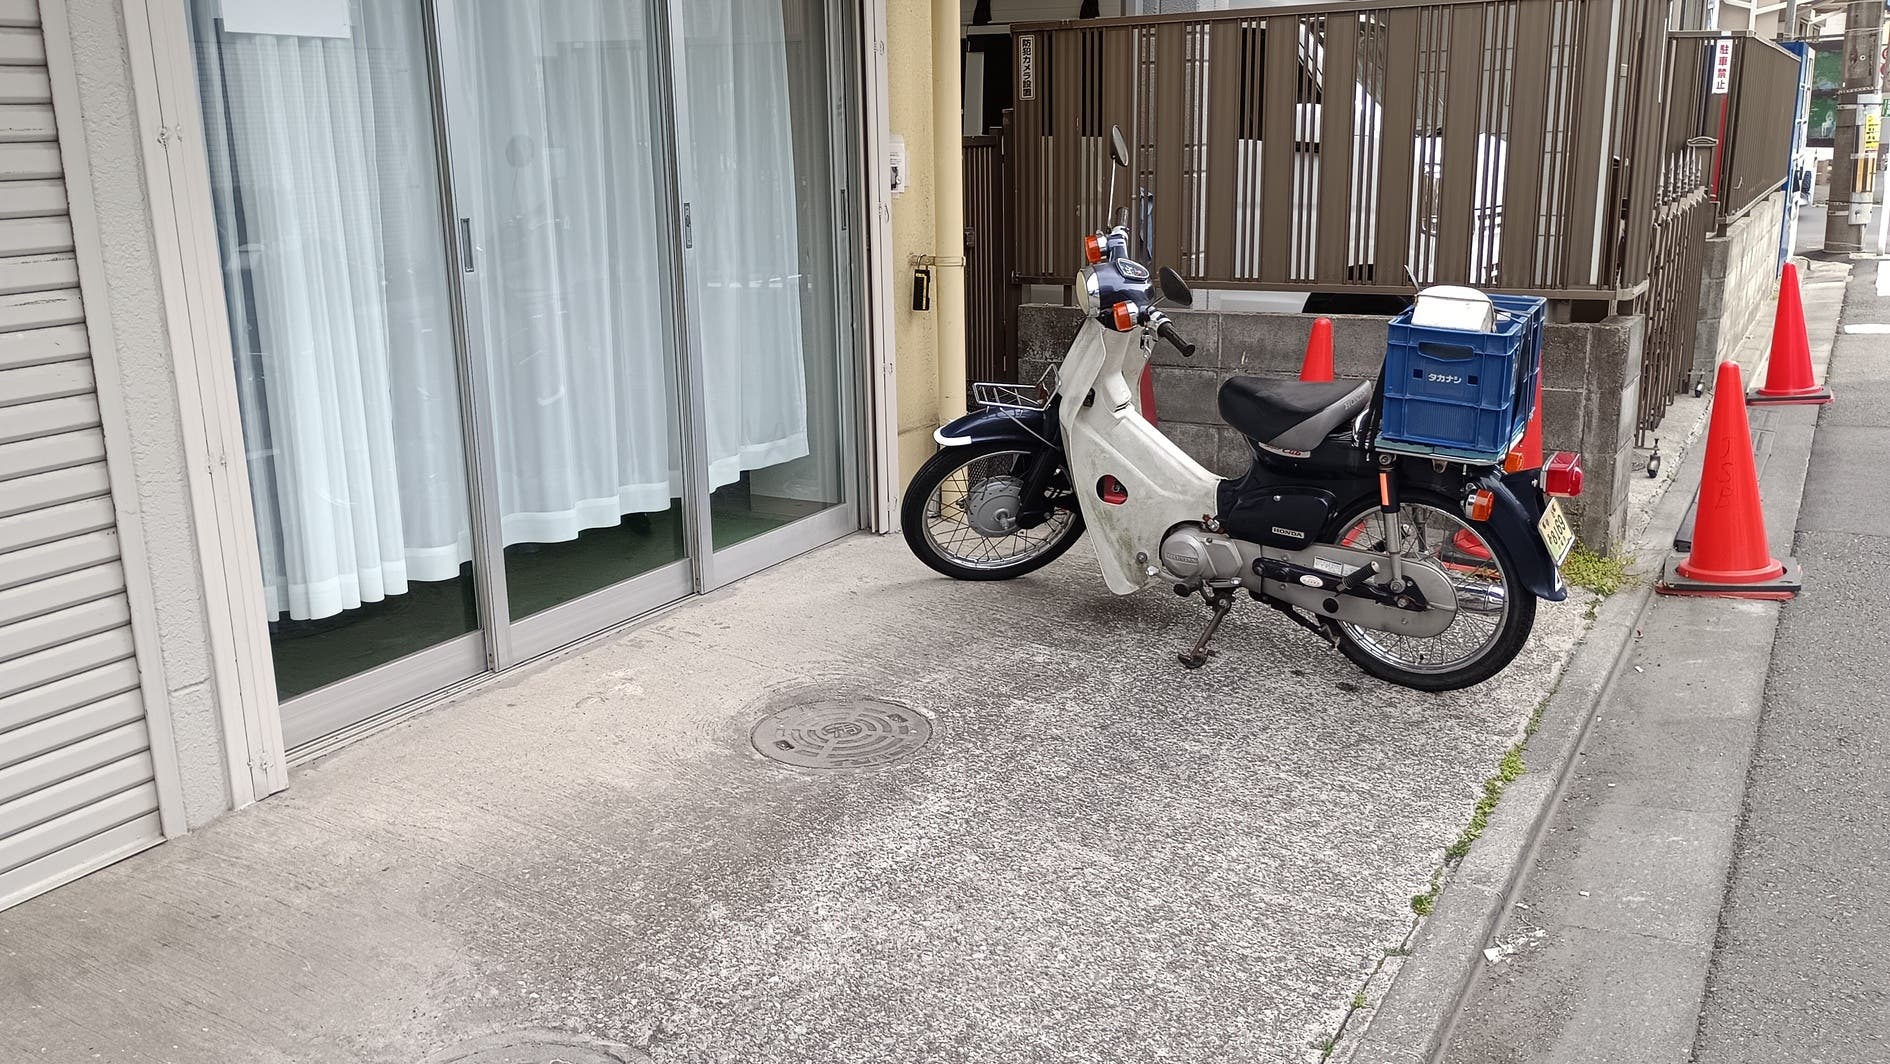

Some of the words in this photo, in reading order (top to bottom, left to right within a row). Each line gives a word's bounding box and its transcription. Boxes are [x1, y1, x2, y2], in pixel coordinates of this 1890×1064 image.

[1022, 38, 1032, 97] 防犯カメラ設置
[1715, 44, 1730, 90] 駐車禁止
[1428, 373, 1462, 384] タカナシ
[1273, 527, 1303, 538] HONDA
[1551, 514, 1566, 545] 8169
